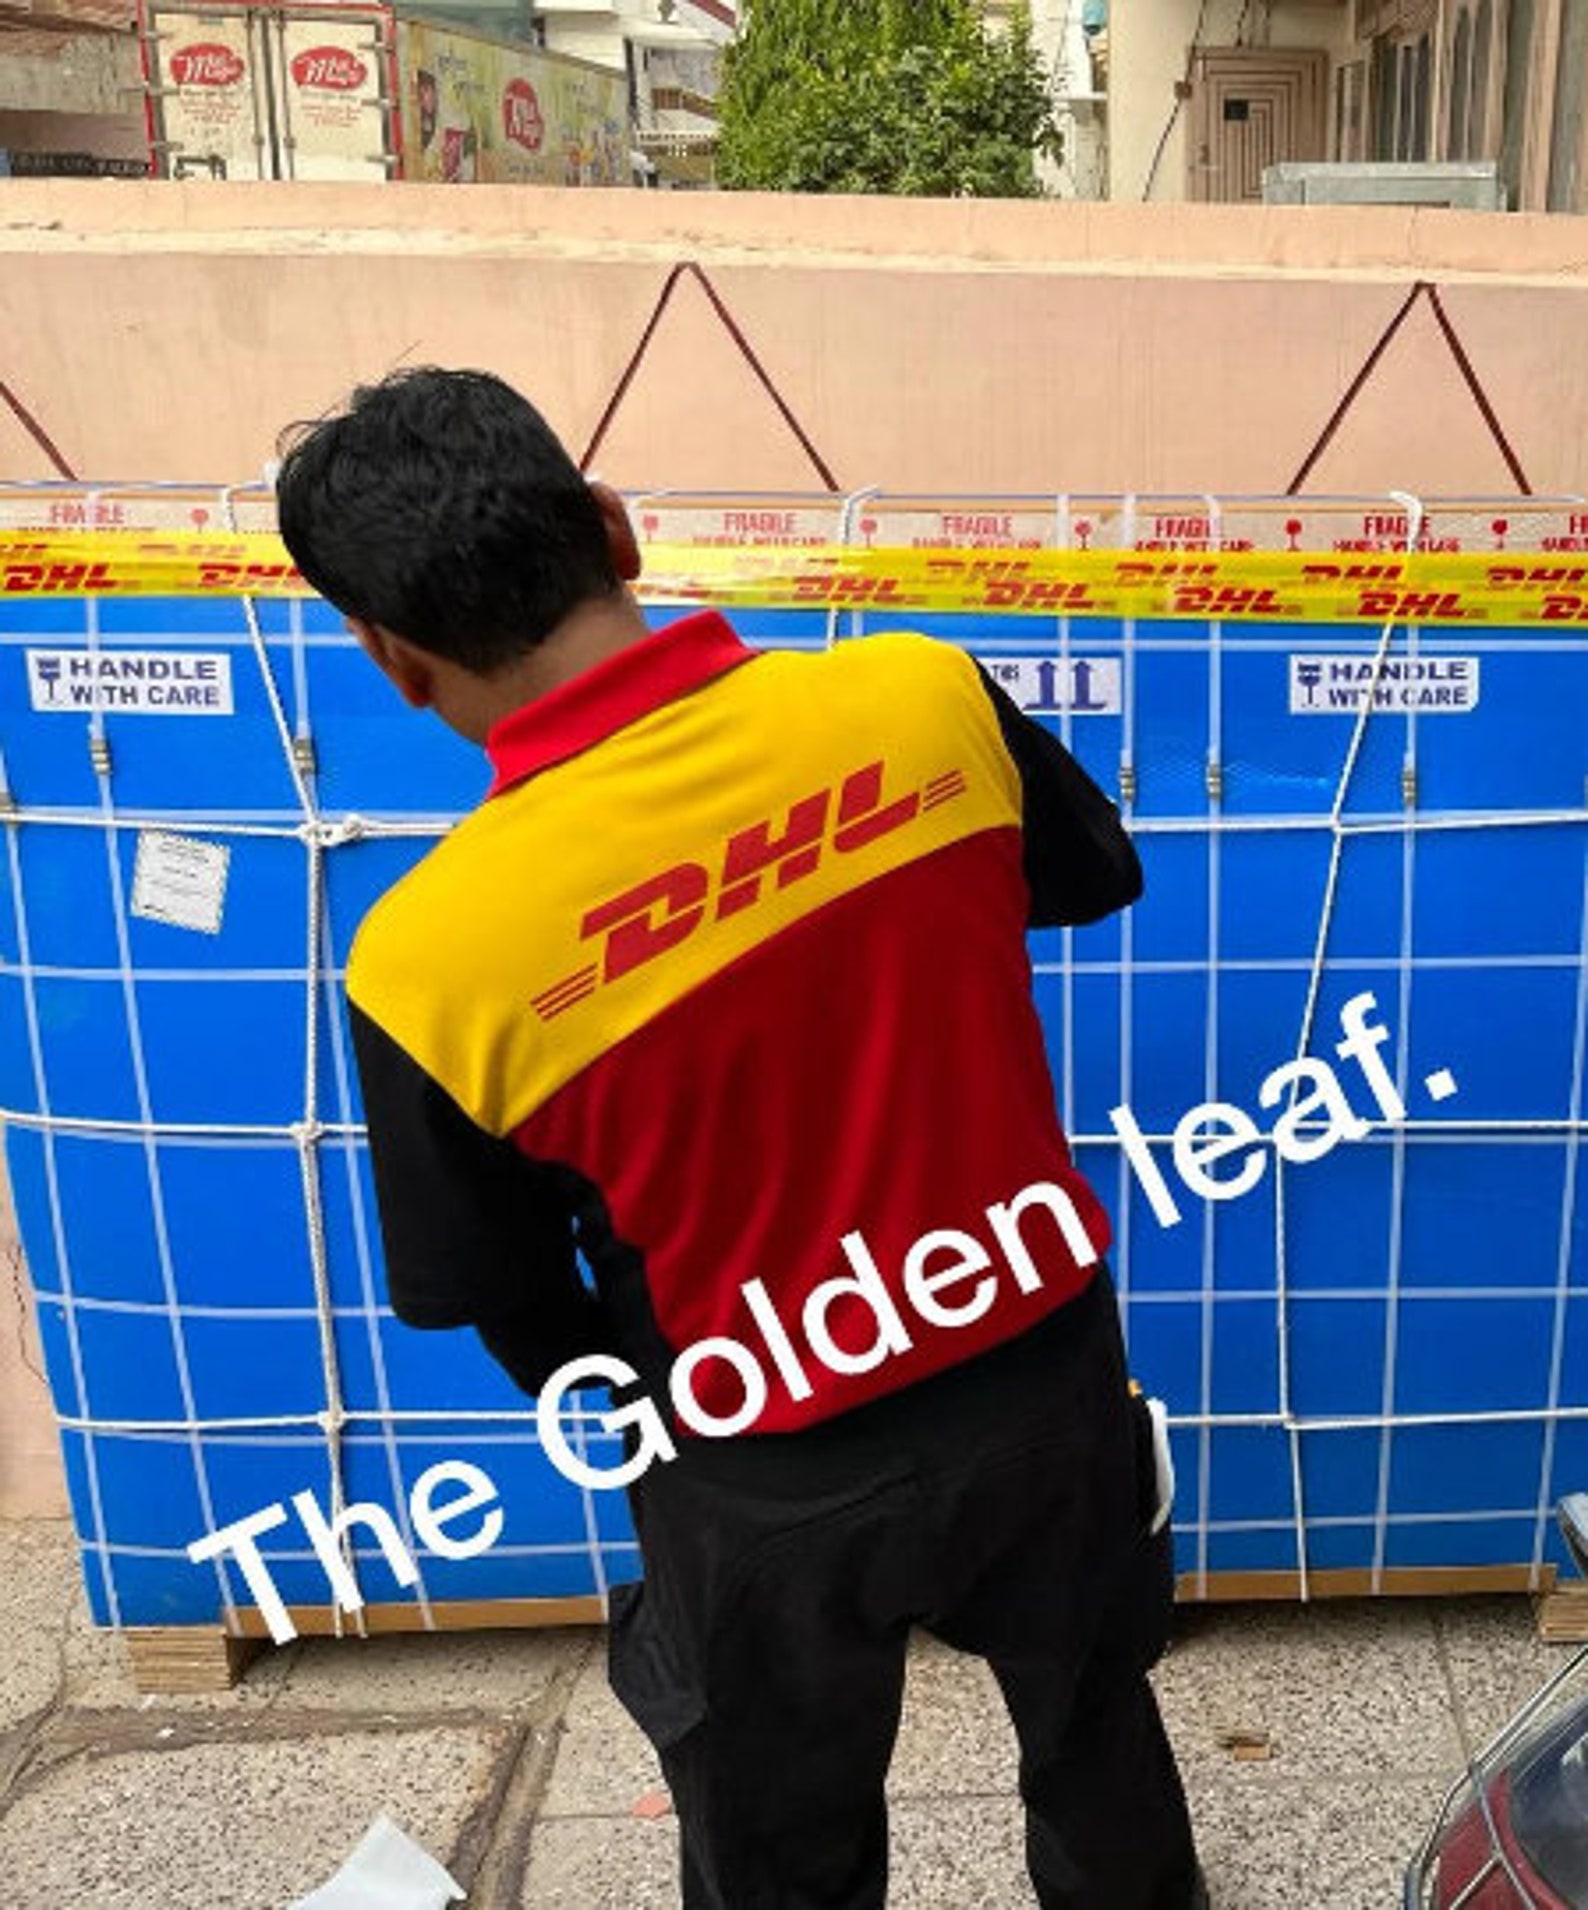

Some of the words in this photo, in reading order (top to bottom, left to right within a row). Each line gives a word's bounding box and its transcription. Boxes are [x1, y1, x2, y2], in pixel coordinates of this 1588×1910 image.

[723, 512, 797, 532] FRAGILE
[942, 515, 1012, 537] FRAGILE
[3, 564, 118, 591] DHL
[793, 575, 903, 602] DHL
[983, 580, 1095, 608] DHL
[1174, 585, 1283, 613] DHL
[1358, 591, 1466, 618] DHL
[69, 656, 218, 681] HANDLE
[1330, 661, 1469, 682] HANDLE
[147, 685, 220, 706] CARE
[1400, 686, 1468, 706] CARE
[580, 760, 920, 985] DHL
